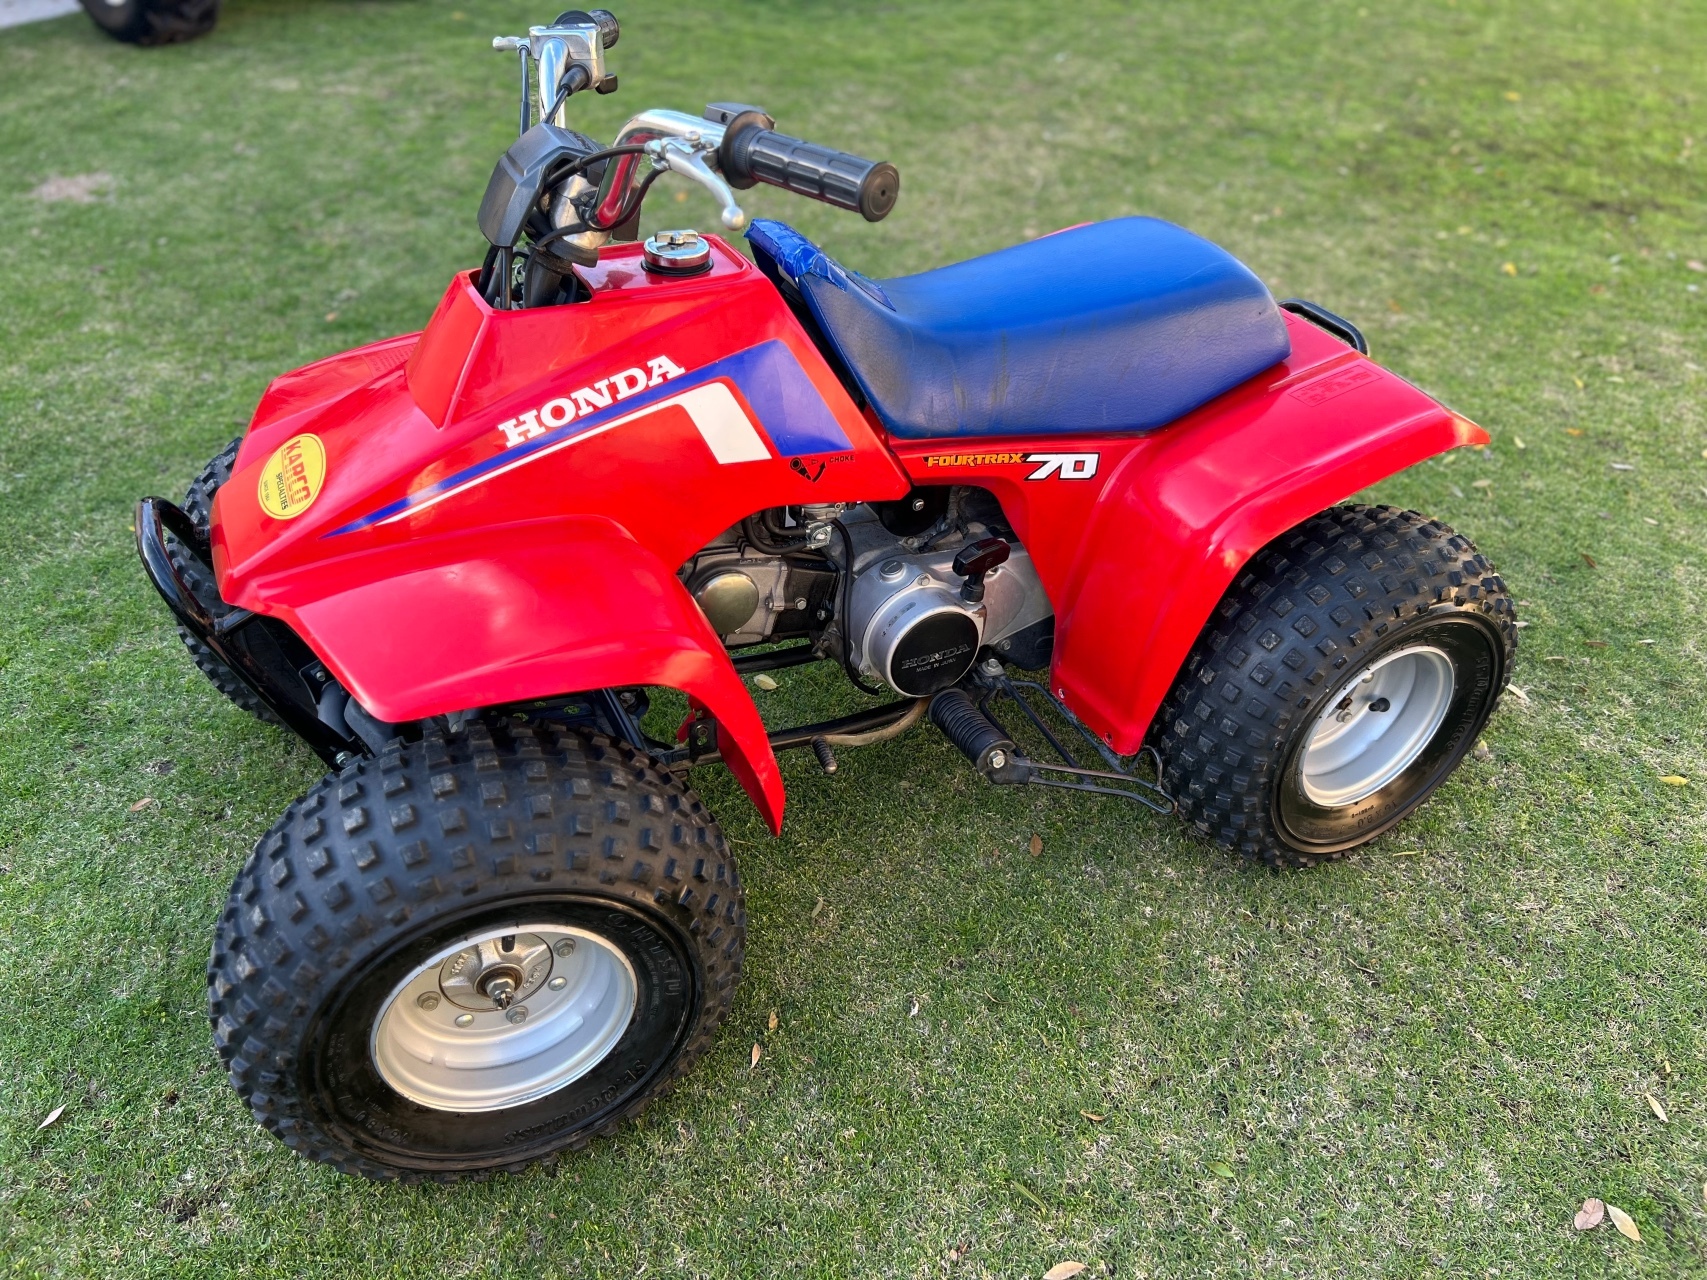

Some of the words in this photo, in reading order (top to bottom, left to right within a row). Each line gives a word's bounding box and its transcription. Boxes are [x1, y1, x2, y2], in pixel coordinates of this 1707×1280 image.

[498, 355, 686, 448] HONDA
[284, 440, 311, 505] KARCO
[829, 455, 855, 465] CHOKE
[927, 453, 1024, 468] FOURTRAX
[1025, 452, 1100, 481] 70
[276, 472, 289, 510] SPECIALTIES
[901, 644, 970, 669] HONDA
[916, 664, 931, 673] MADE
[941, 658, 956, 667] JAPAN
